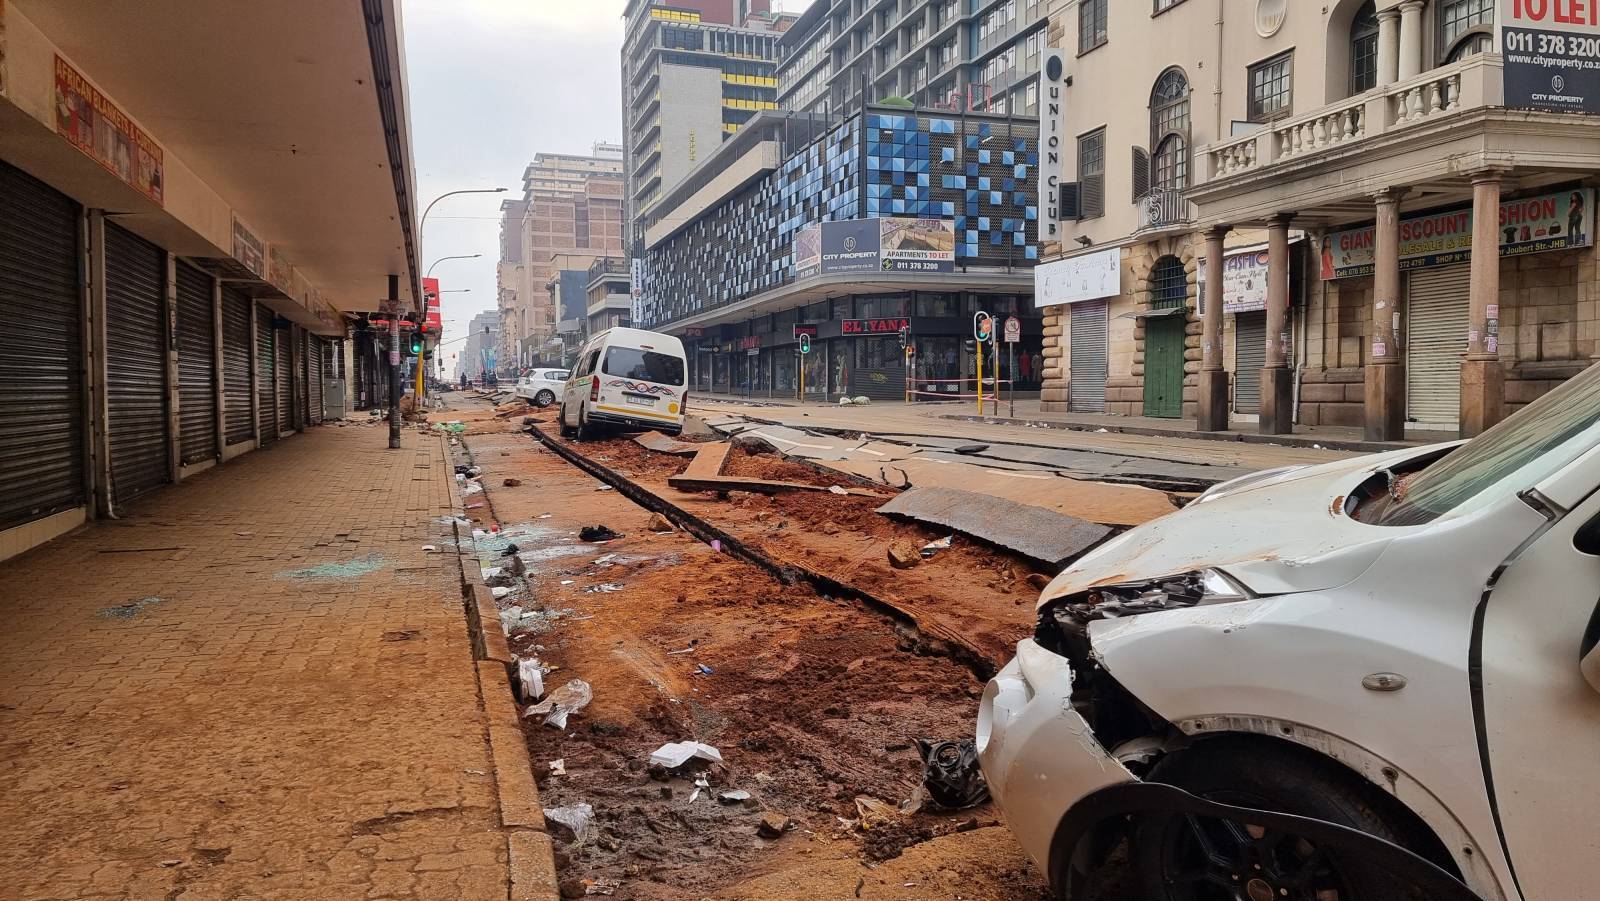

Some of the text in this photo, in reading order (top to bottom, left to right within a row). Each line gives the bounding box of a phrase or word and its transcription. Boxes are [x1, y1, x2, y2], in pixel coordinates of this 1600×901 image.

[1506, 31, 1533, 52] 011
[1538, 34, 1566, 55] 378
[1508, 54, 1600, 70] www.cityproperty.co.z
[56, 58, 93, 104] AFRICAN
[93, 90, 129, 134] BLANKETS
[1531, 93, 1584, 103] CITY PROPERTY
[1047, 86, 1059, 235] UNION CLUB
[1340, 196, 1556, 251] GIAN SCOUNT SHION
[840, 251, 878, 260] PROPERTY
[886, 250, 928, 259] APARTMENTS
[1399, 239, 1443, 256] LESALE
[1506, 244, 1534, 255] Joubert
[897, 261, 939, 270] 011 378 3200
[1223, 253, 1268, 270] ASHIO
